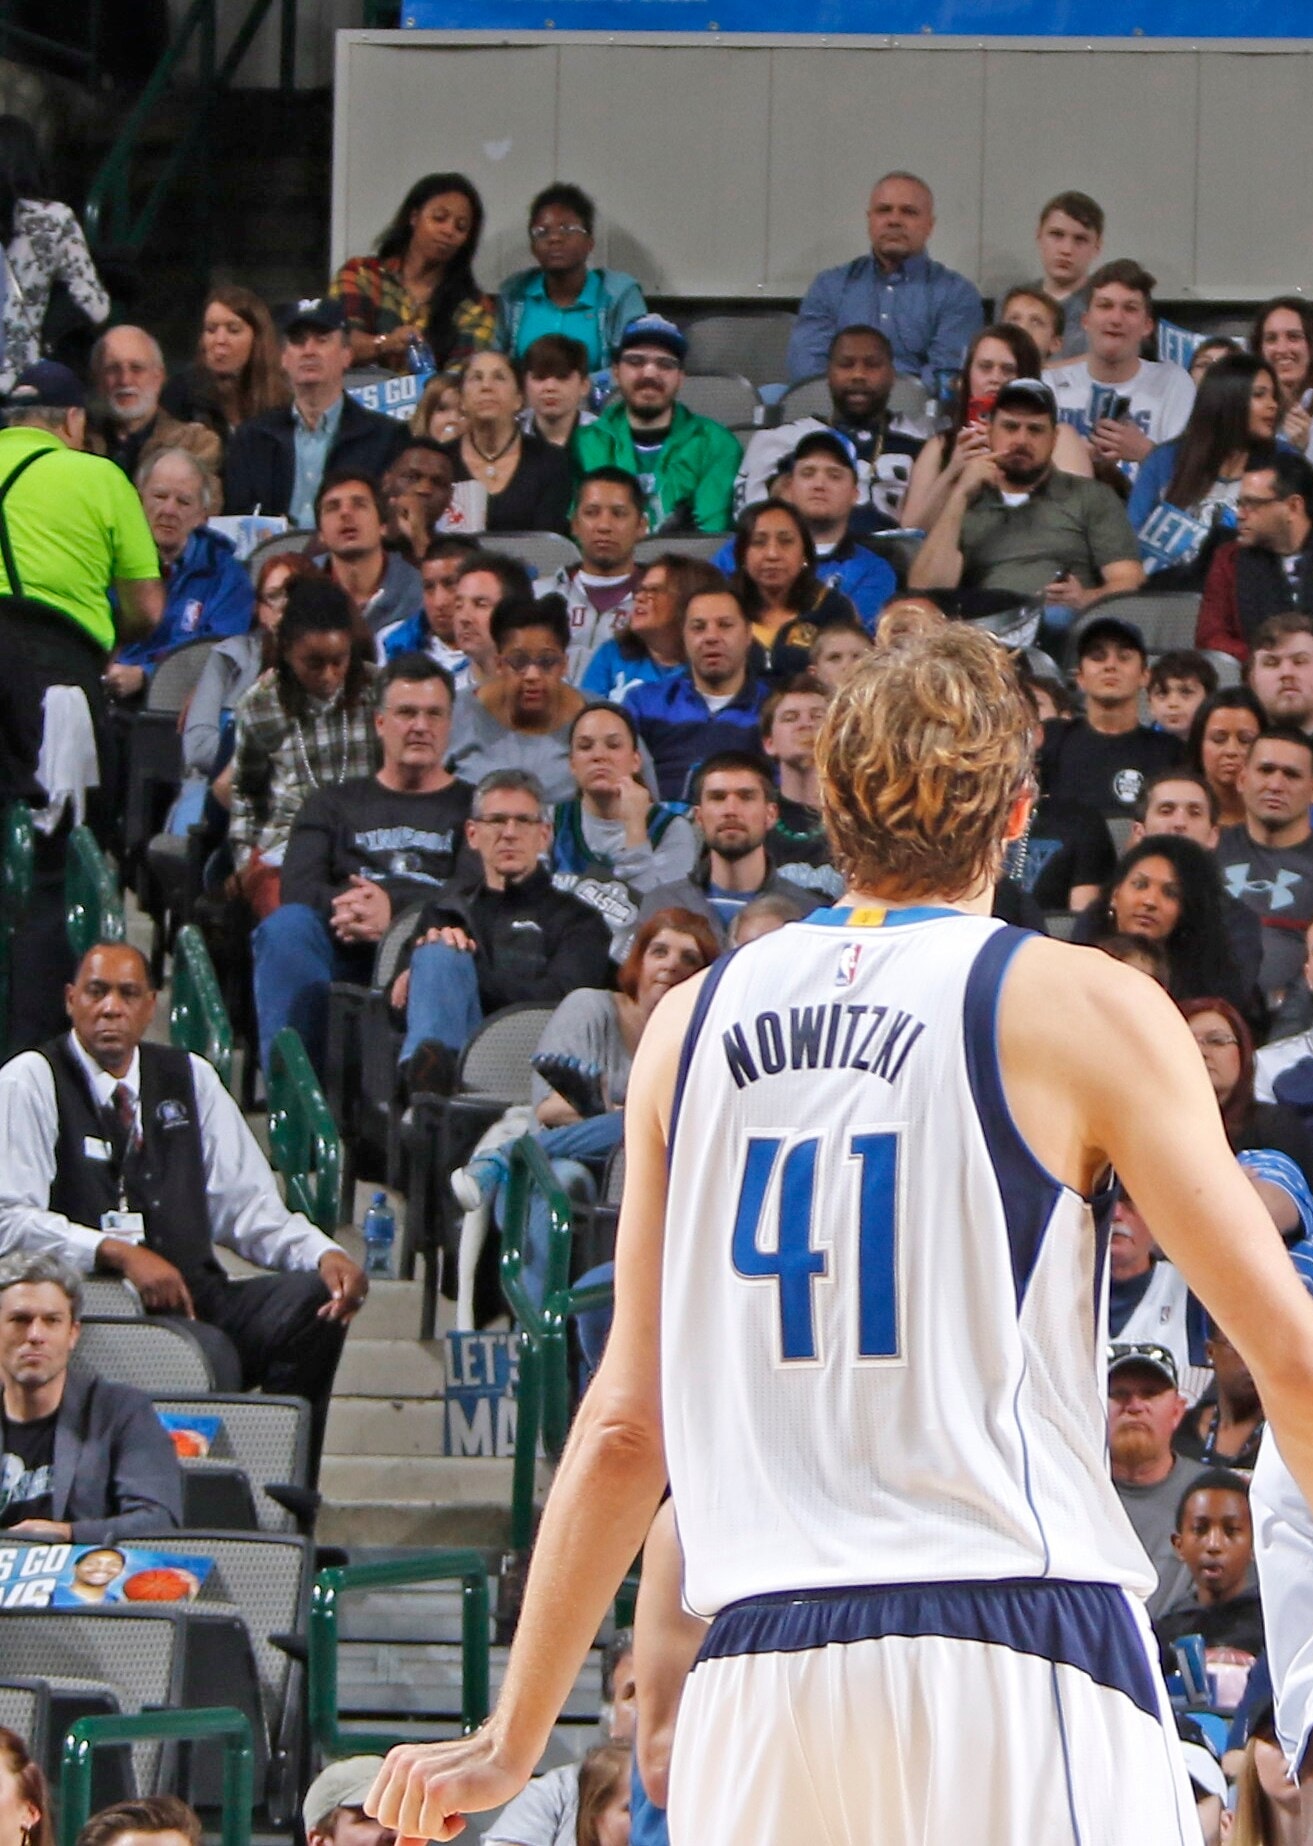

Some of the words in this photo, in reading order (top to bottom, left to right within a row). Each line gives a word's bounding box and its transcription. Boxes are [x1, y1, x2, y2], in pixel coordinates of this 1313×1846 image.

[722, 1003, 926, 1090] NOWITZKI
[731, 1128, 905, 1365] 41
[448, 1397, 546, 1458] MA
[20, 1544, 72, 1578] GO
